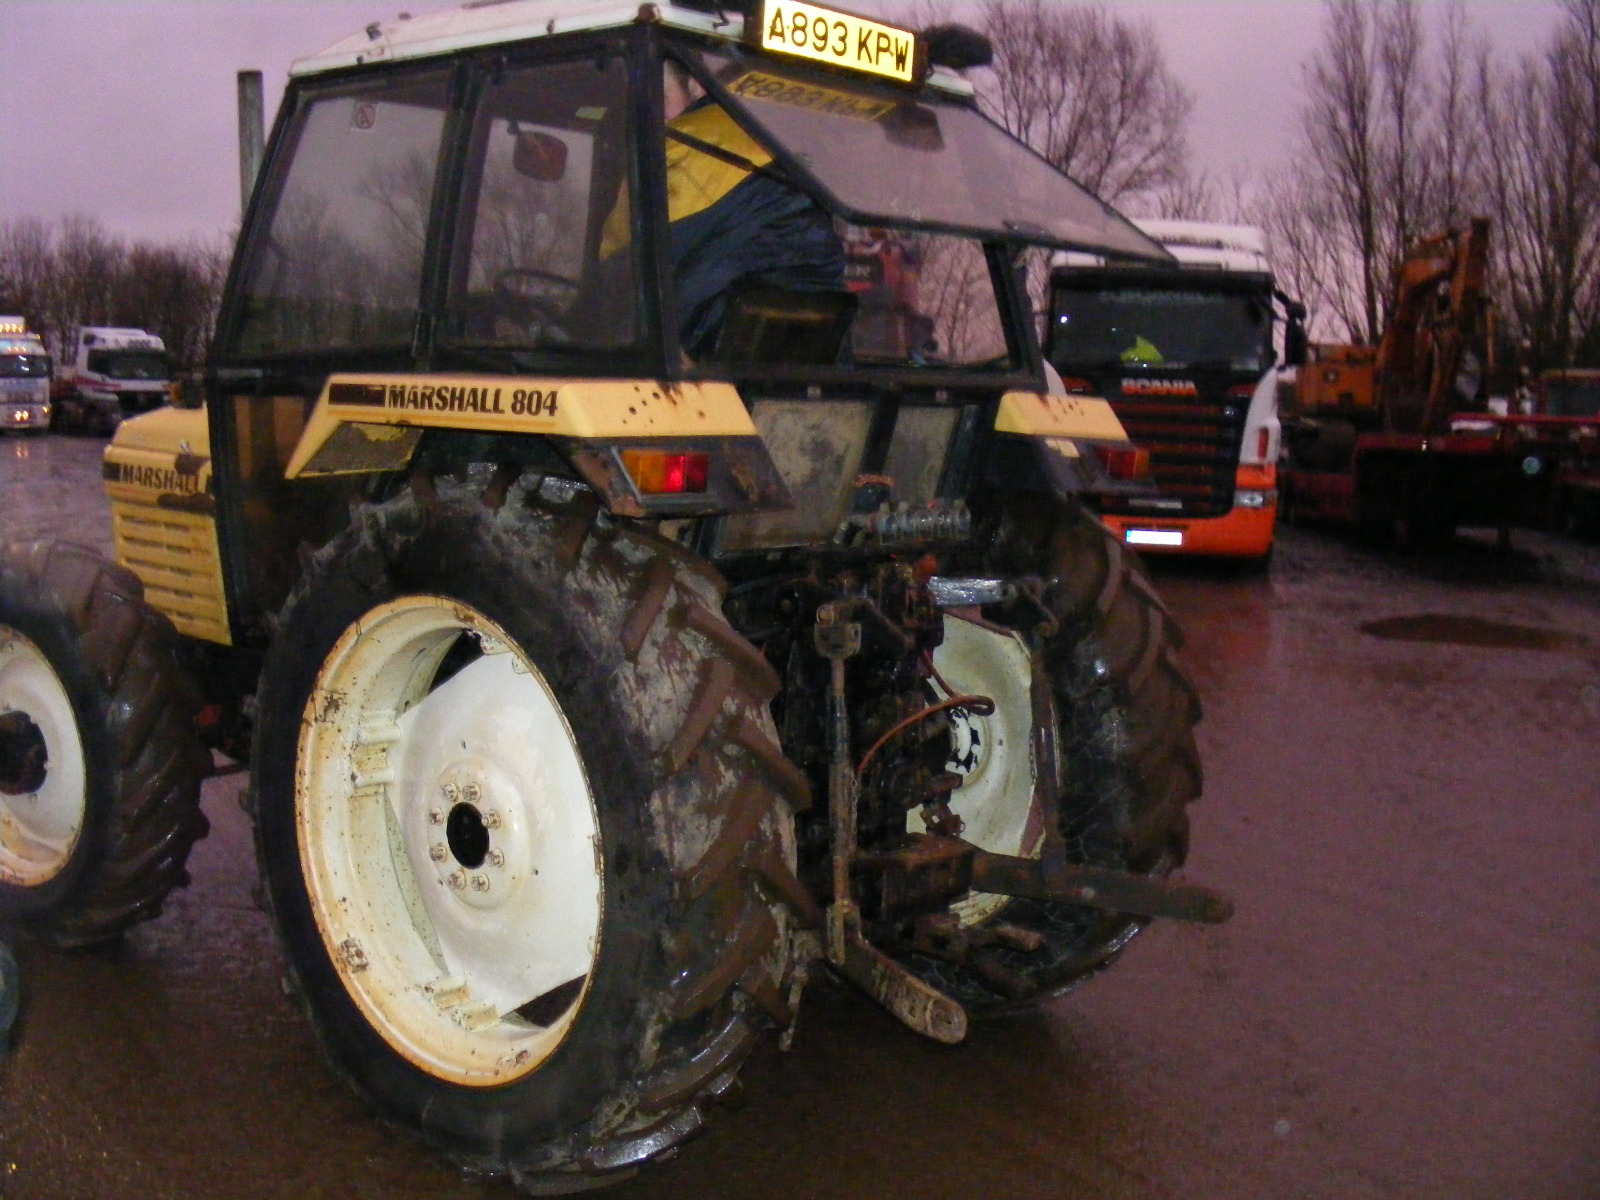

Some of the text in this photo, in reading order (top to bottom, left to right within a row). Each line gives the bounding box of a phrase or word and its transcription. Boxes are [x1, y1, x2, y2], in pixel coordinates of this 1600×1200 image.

[769, 7, 909, 72] A893 KPW
[387, 384, 558, 417] MARSHALL 804
[1121, 378, 1197, 396] SCANIA
